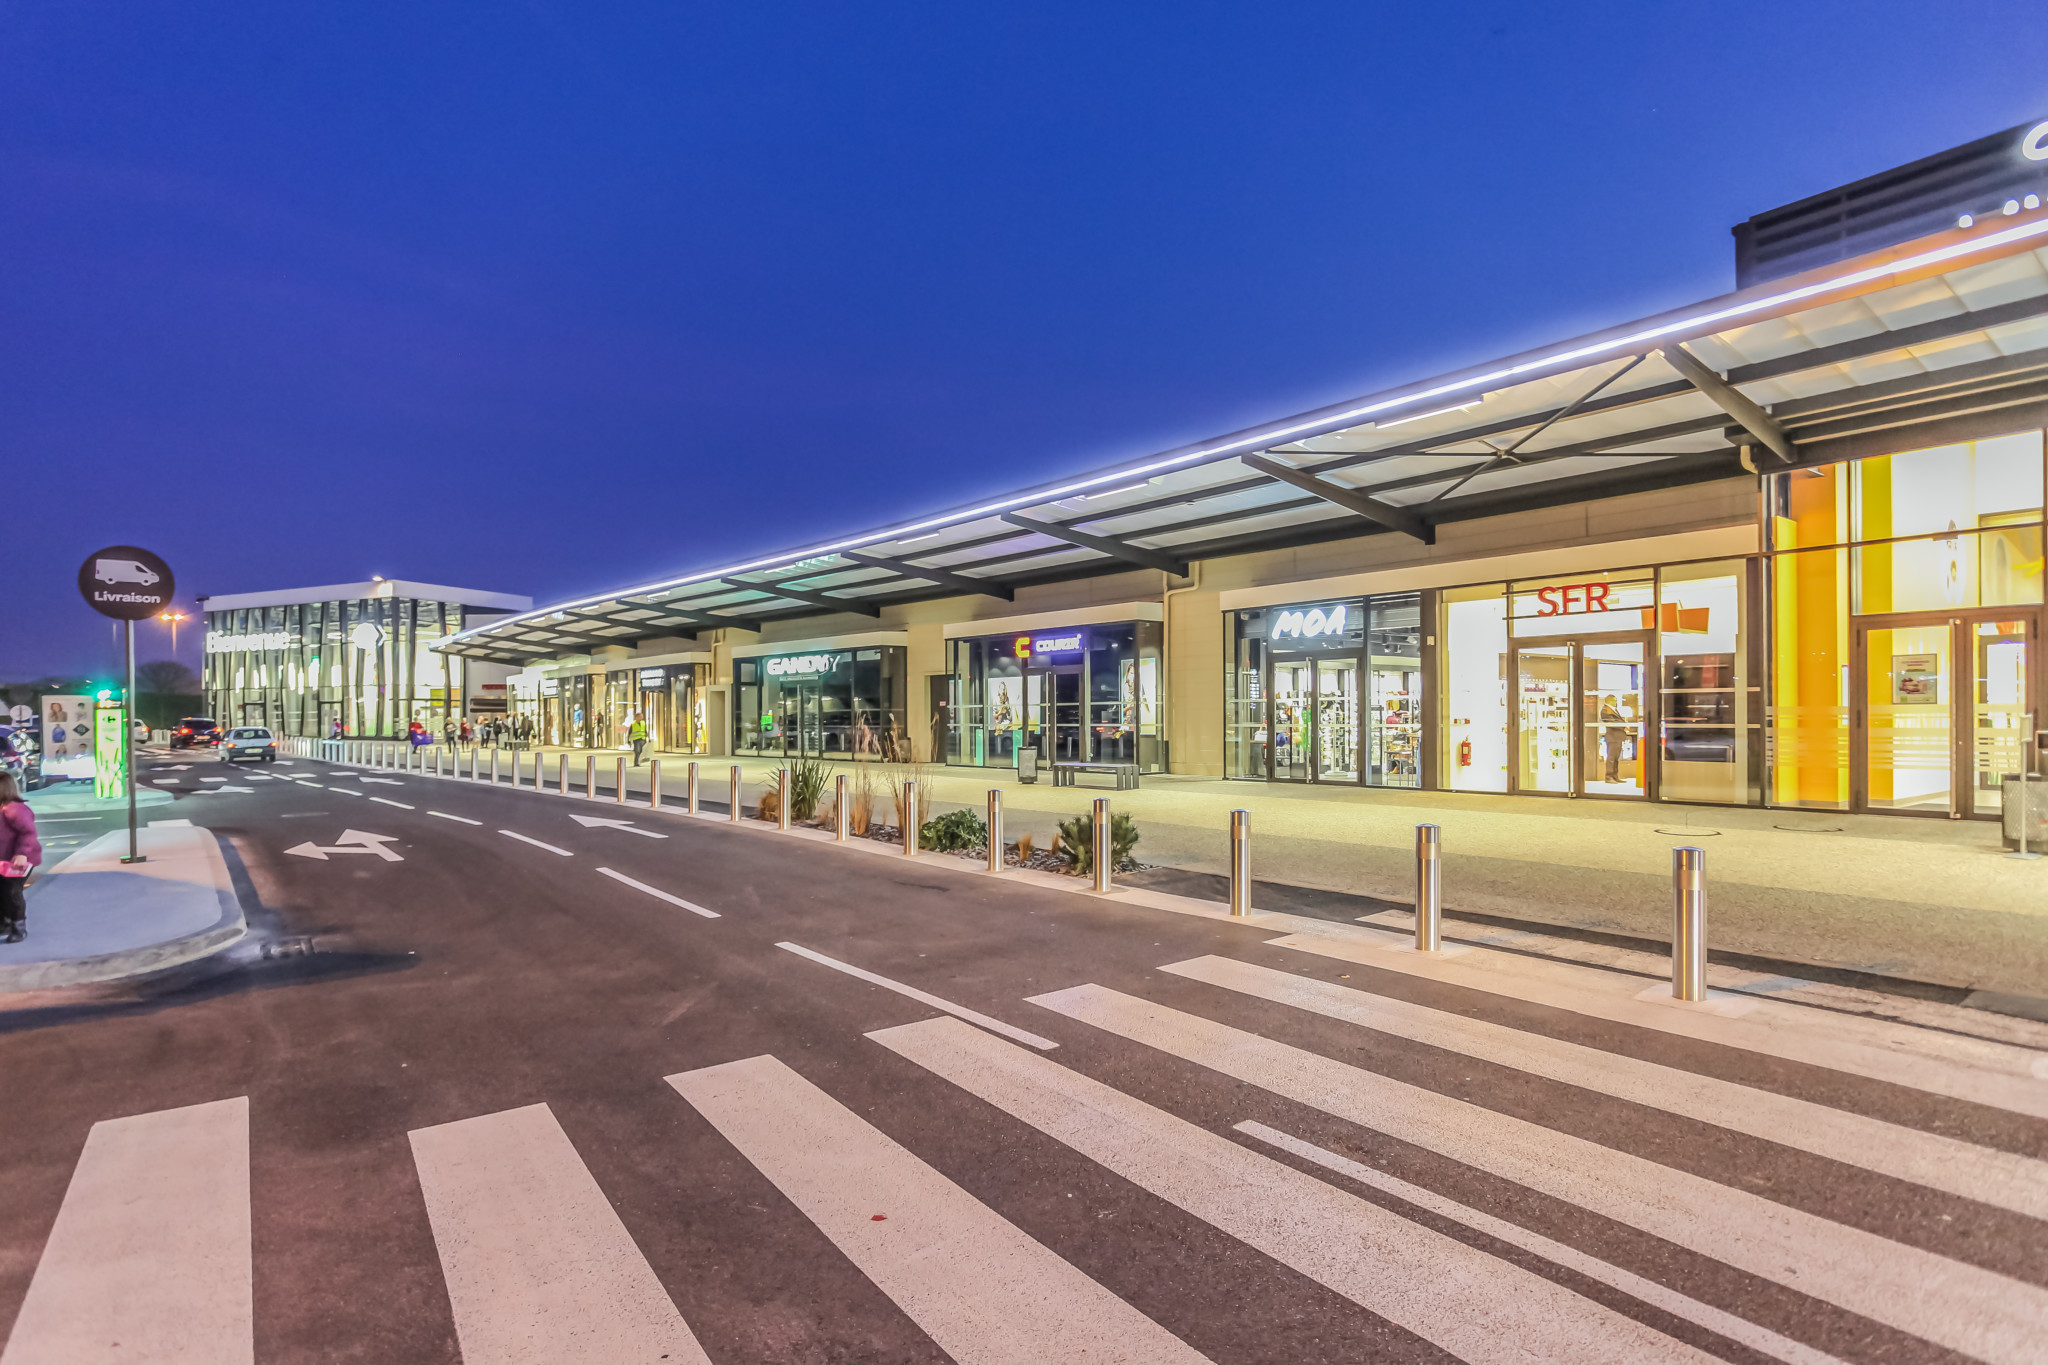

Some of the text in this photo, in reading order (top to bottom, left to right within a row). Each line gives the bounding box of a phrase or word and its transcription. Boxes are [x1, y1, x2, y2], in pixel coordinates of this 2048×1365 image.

[94, 591, 161, 604] Livraison
[1537, 583, 1610, 617] SFR
[1271, 605, 1346, 640] MOA
[206, 629, 291, 654] Bienvenue
